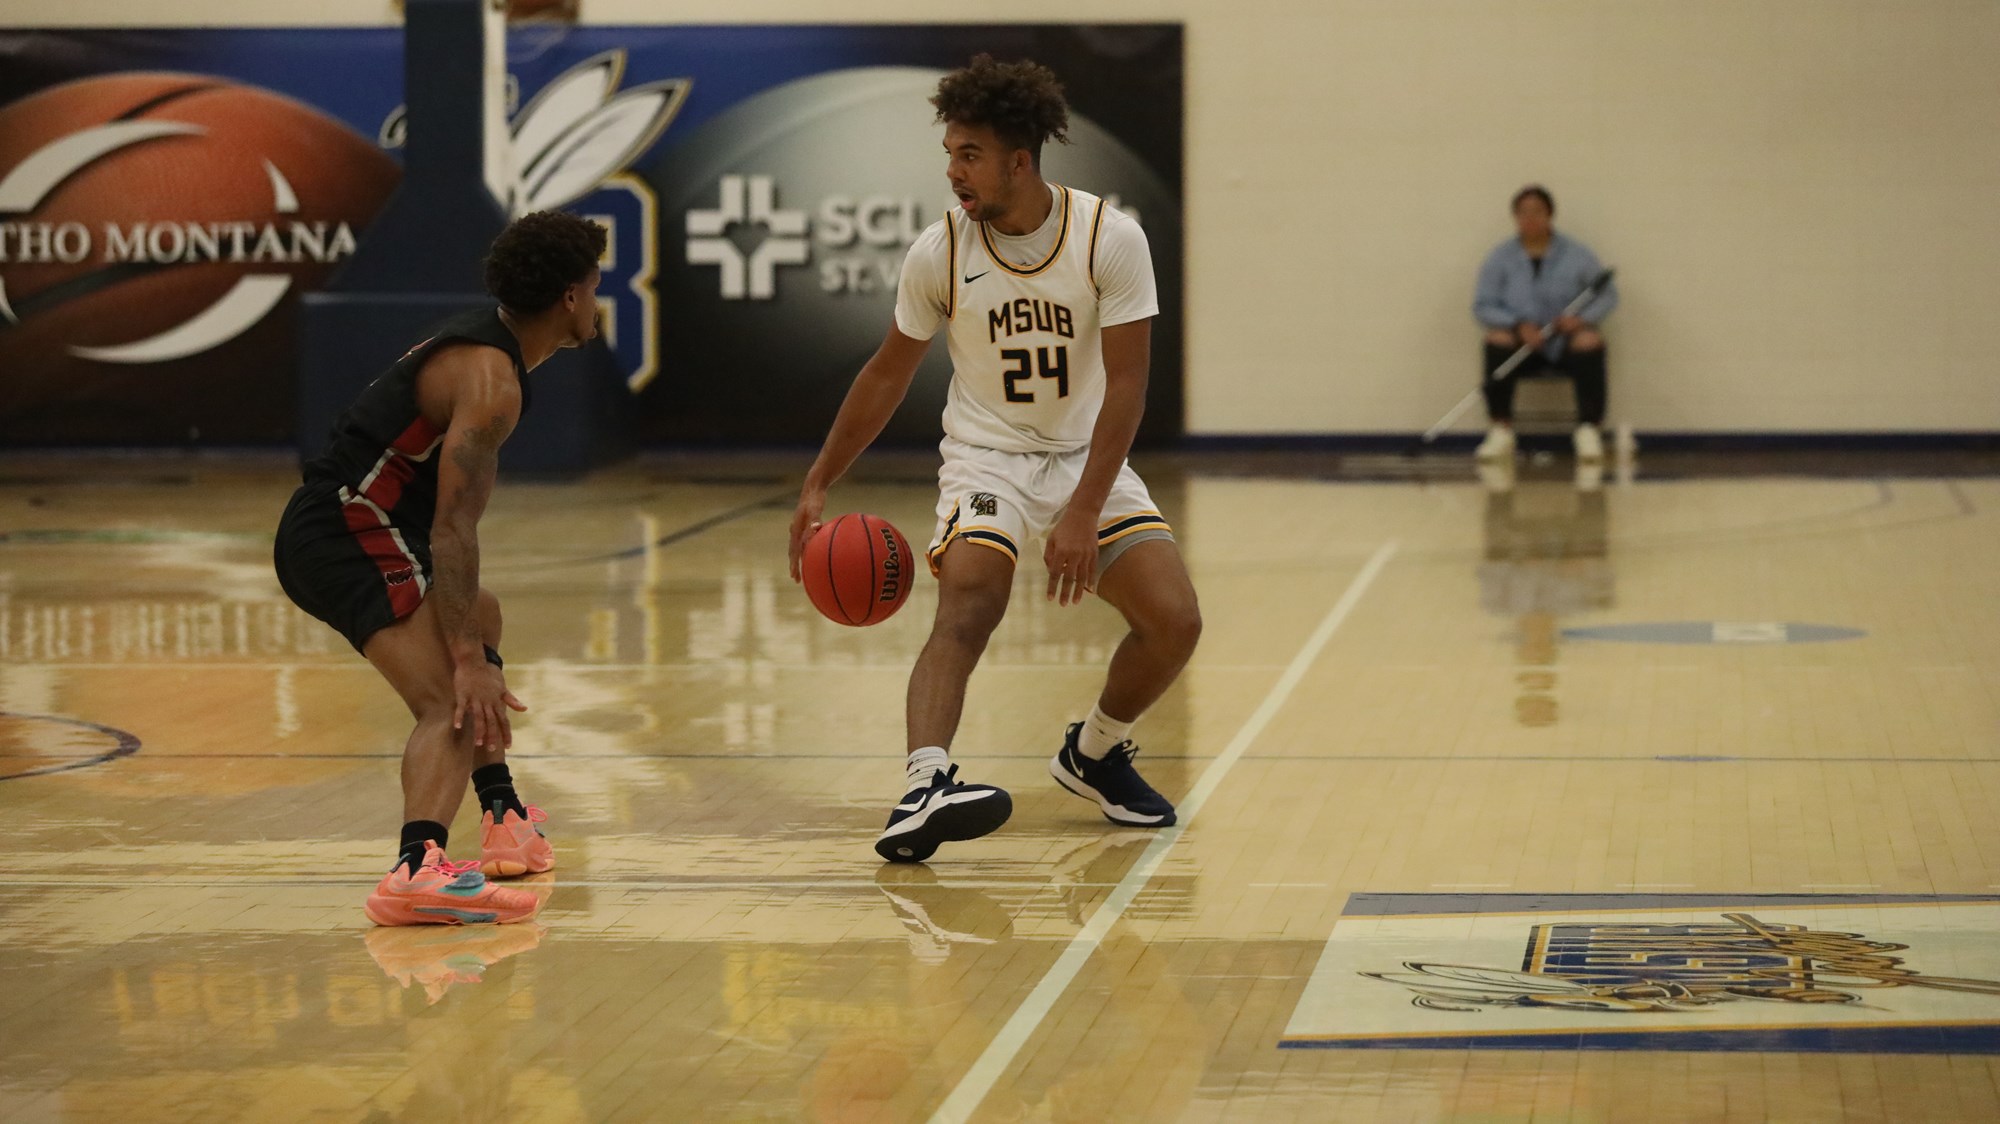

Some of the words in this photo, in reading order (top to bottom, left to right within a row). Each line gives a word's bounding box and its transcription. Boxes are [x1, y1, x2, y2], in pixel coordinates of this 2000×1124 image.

[103, 219, 357, 264] MONTANA
[988, 298, 1075, 344] MSUB
[1000, 345, 1070, 404] 24
[880, 528, 900, 602] Wilson
